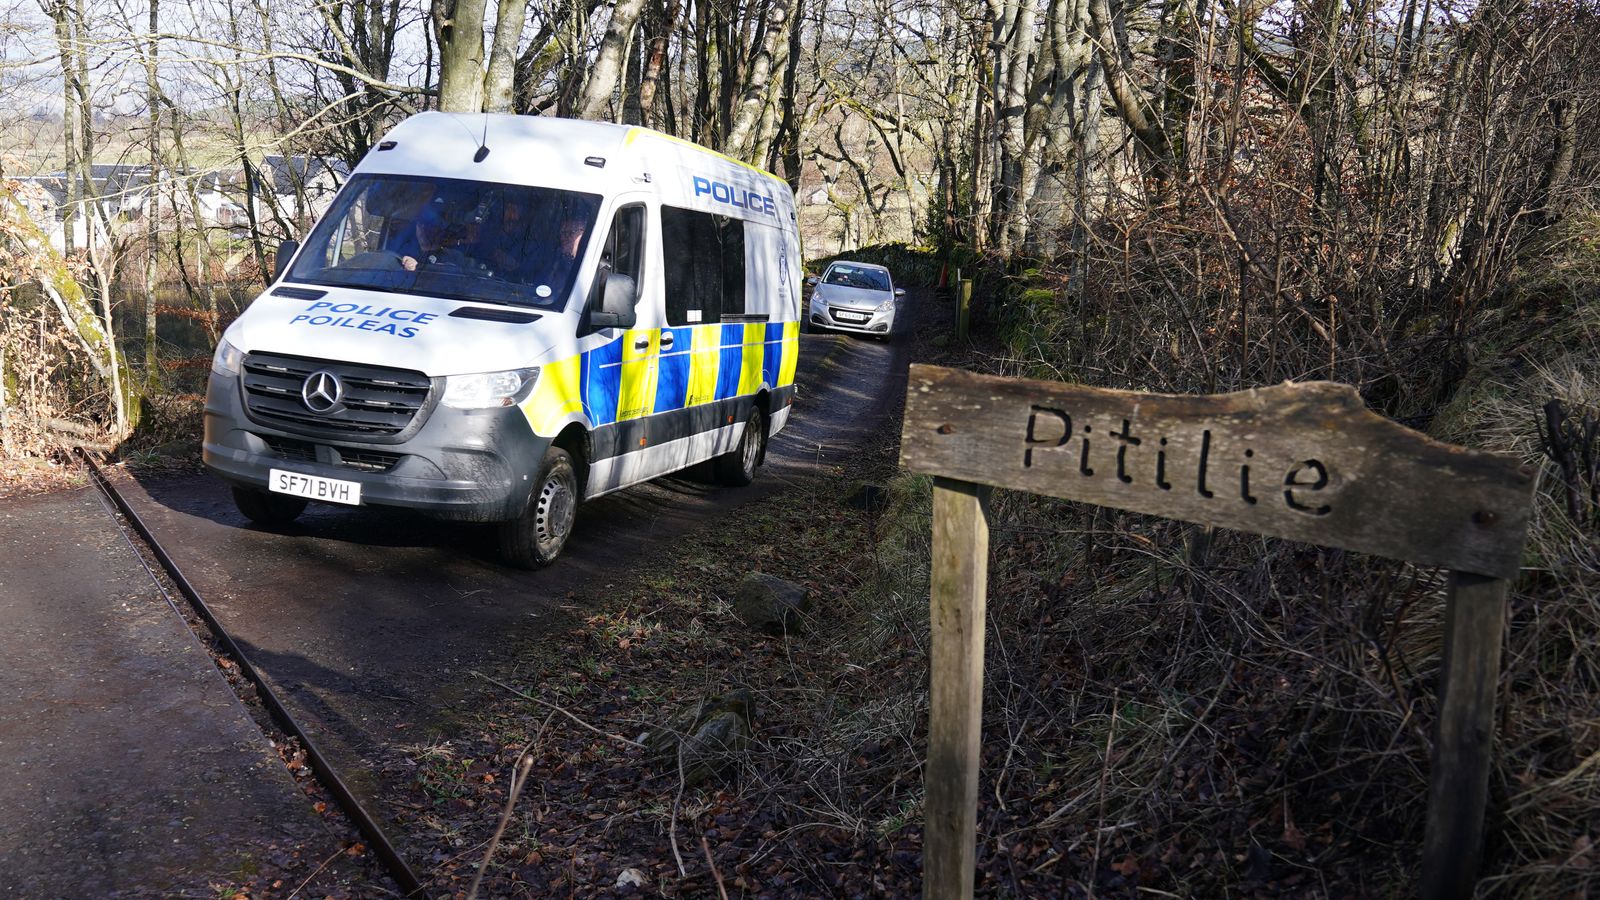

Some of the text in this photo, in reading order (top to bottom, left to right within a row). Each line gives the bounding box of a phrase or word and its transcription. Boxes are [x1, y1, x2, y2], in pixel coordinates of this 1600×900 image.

[693, 175, 776, 216] POLICE
[289, 314, 420, 338] POILEAS
[306, 301, 439, 325] POLICE
[1024, 404, 1331, 516] Pitilie
[280, 474, 349, 501] SF71 BVH
